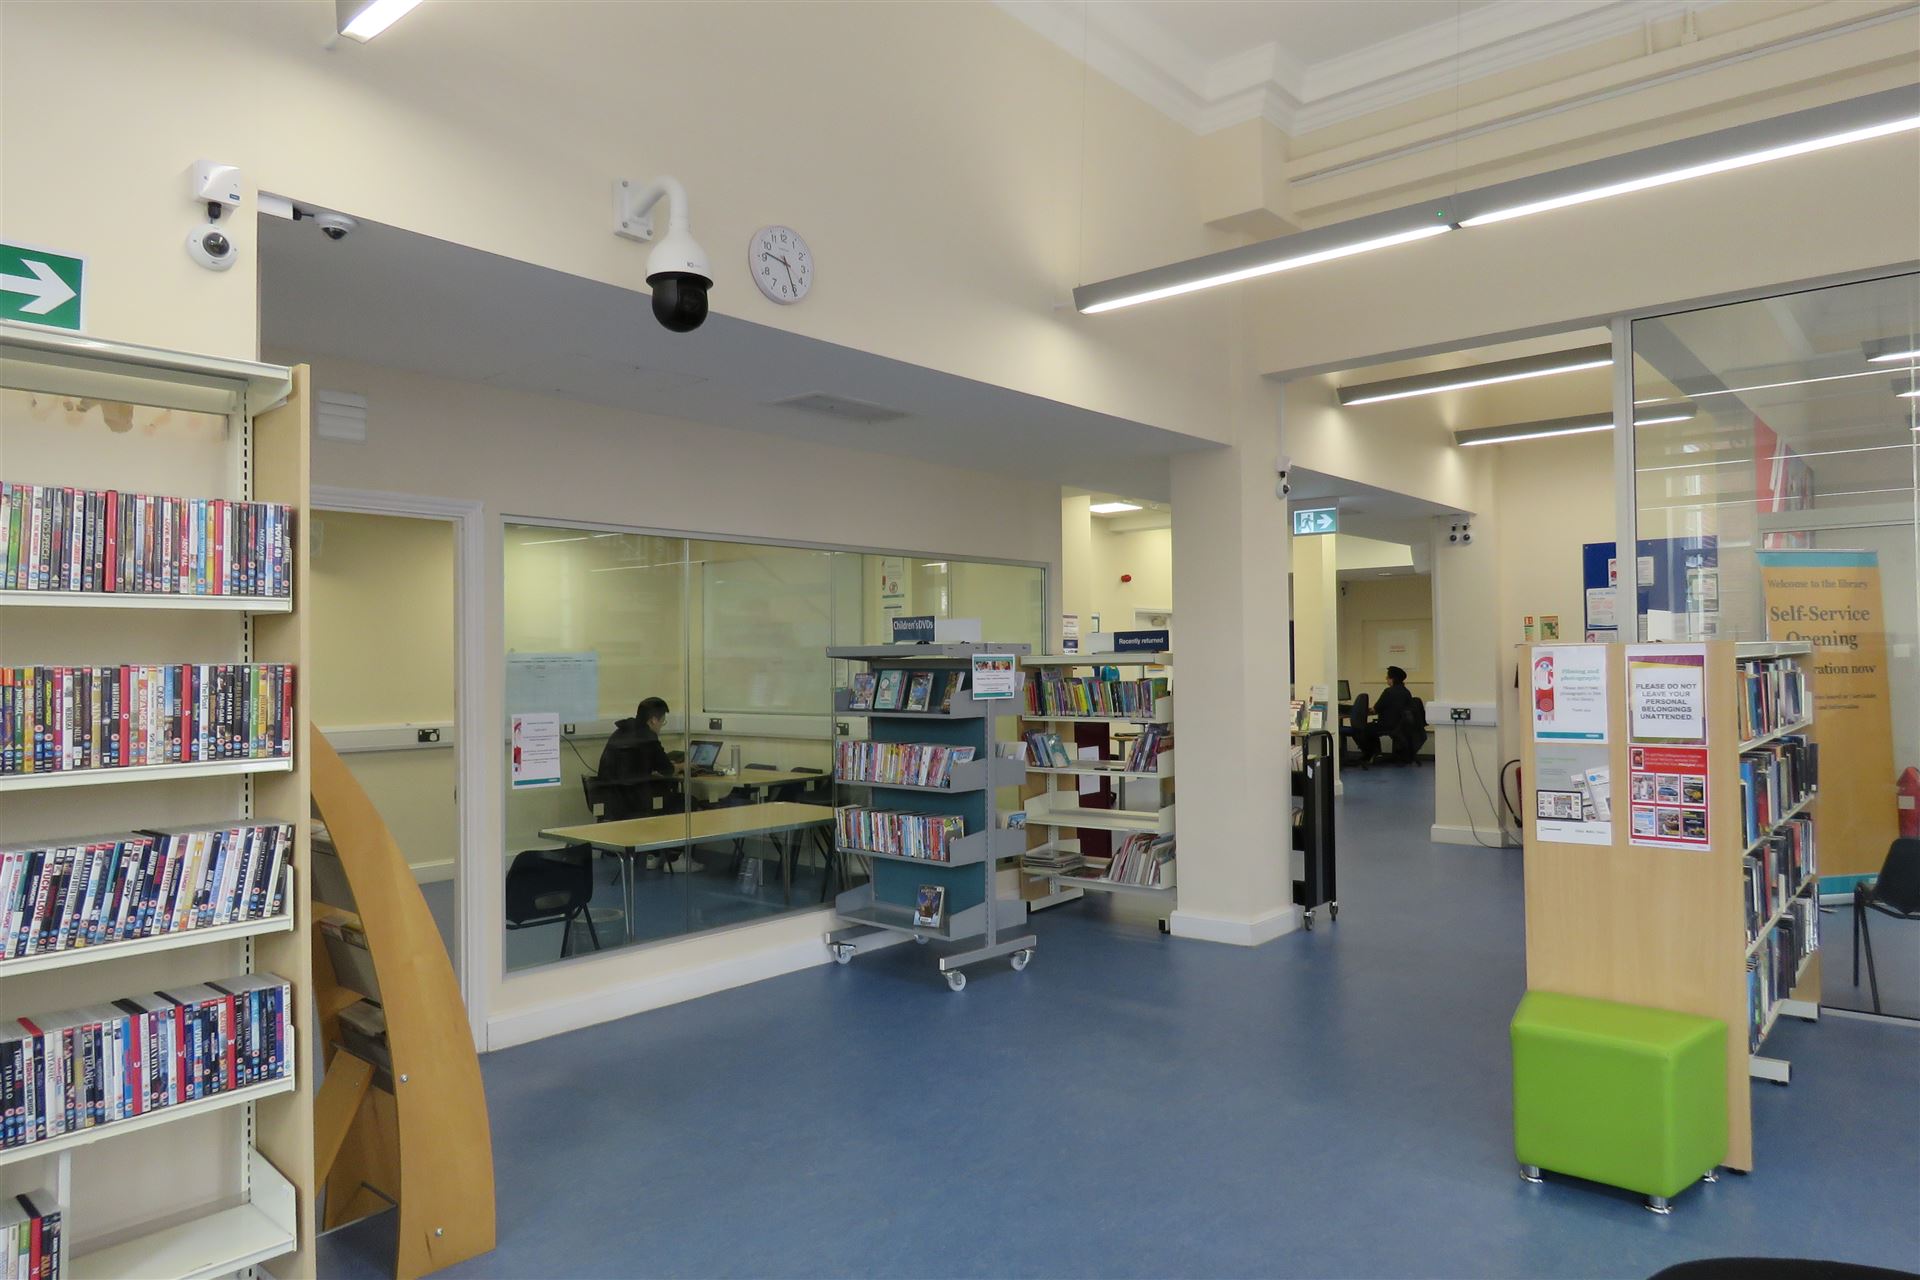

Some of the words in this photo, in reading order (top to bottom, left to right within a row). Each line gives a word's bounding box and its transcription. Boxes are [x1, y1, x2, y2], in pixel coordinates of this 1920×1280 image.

[764, 240, 772, 250] 10
[771, 234, 776, 244] 11
[780, 234, 788, 243] 12
[792, 240, 795, 250] 1
[798, 252, 804, 261] 2
[764, 266, 770, 275] 8
[800, 266, 806, 274] 3
[772, 278, 778, 287] 7
[782, 286, 788, 294] 6
[1767, 579, 1808, 588] Welcome
[1810, 580, 1819, 588] to
[1821, 579, 1837, 588] the
[1838, 579, 1868, 590] library
[1770, 605, 1870, 622] Self-Service
[894, 620, 918, 630] Children's
[918, 620, 933, 630] DVDs
[1851, 664, 1876, 675] now
[139, 688, 147, 730] ORANGES
[40, 863, 53, 892] STUCK
[238, 853, 249, 894] SPITFIRE
[161, 870, 172, 892] EFFECTS
[124, 880, 133, 898] SPY
[35, 900, 46, 921] LOVE
[194, 1029, 202, 1057] VIOLIN
[14, 1048, 23, 1081] TRIPLE
[47, 1050, 55, 1082] TITANIC
[84, 1055, 95, 1090] TRANCE
[5, 1065, 13, 1100] TRUMBO
